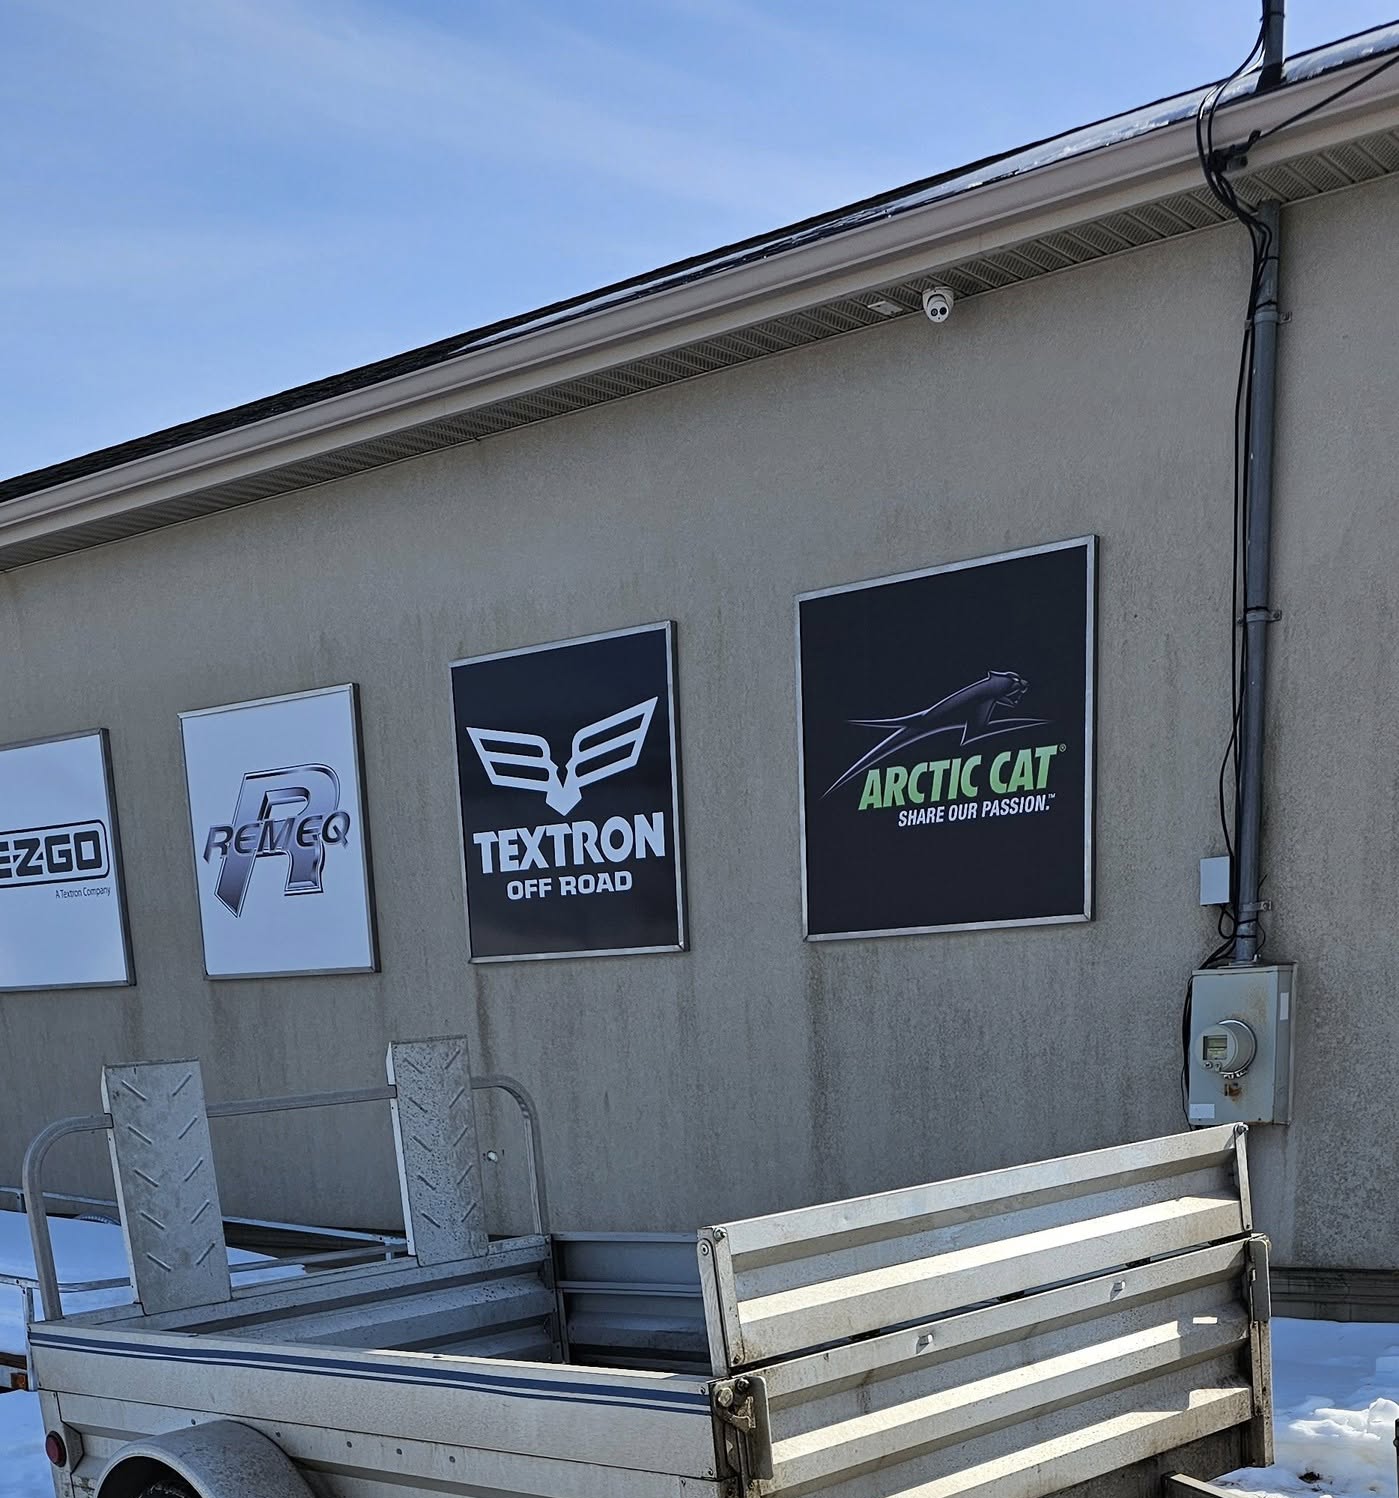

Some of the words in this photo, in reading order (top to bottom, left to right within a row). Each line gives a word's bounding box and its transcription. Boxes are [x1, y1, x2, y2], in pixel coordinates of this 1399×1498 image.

[858, 755, 982, 811] ARCTIC
[898, 806, 945, 827] SHARE
[948, 801, 977, 821] OUR
[203, 811, 351, 864] REMEQ
[473, 812, 666, 874] TEXTRON
[56, 890, 60, 899] A
[60, 889, 82, 899] Textron
[82, 886, 111, 898] Company
[506, 877, 552, 900] OFF
[558, 870, 633, 896] ROAD
